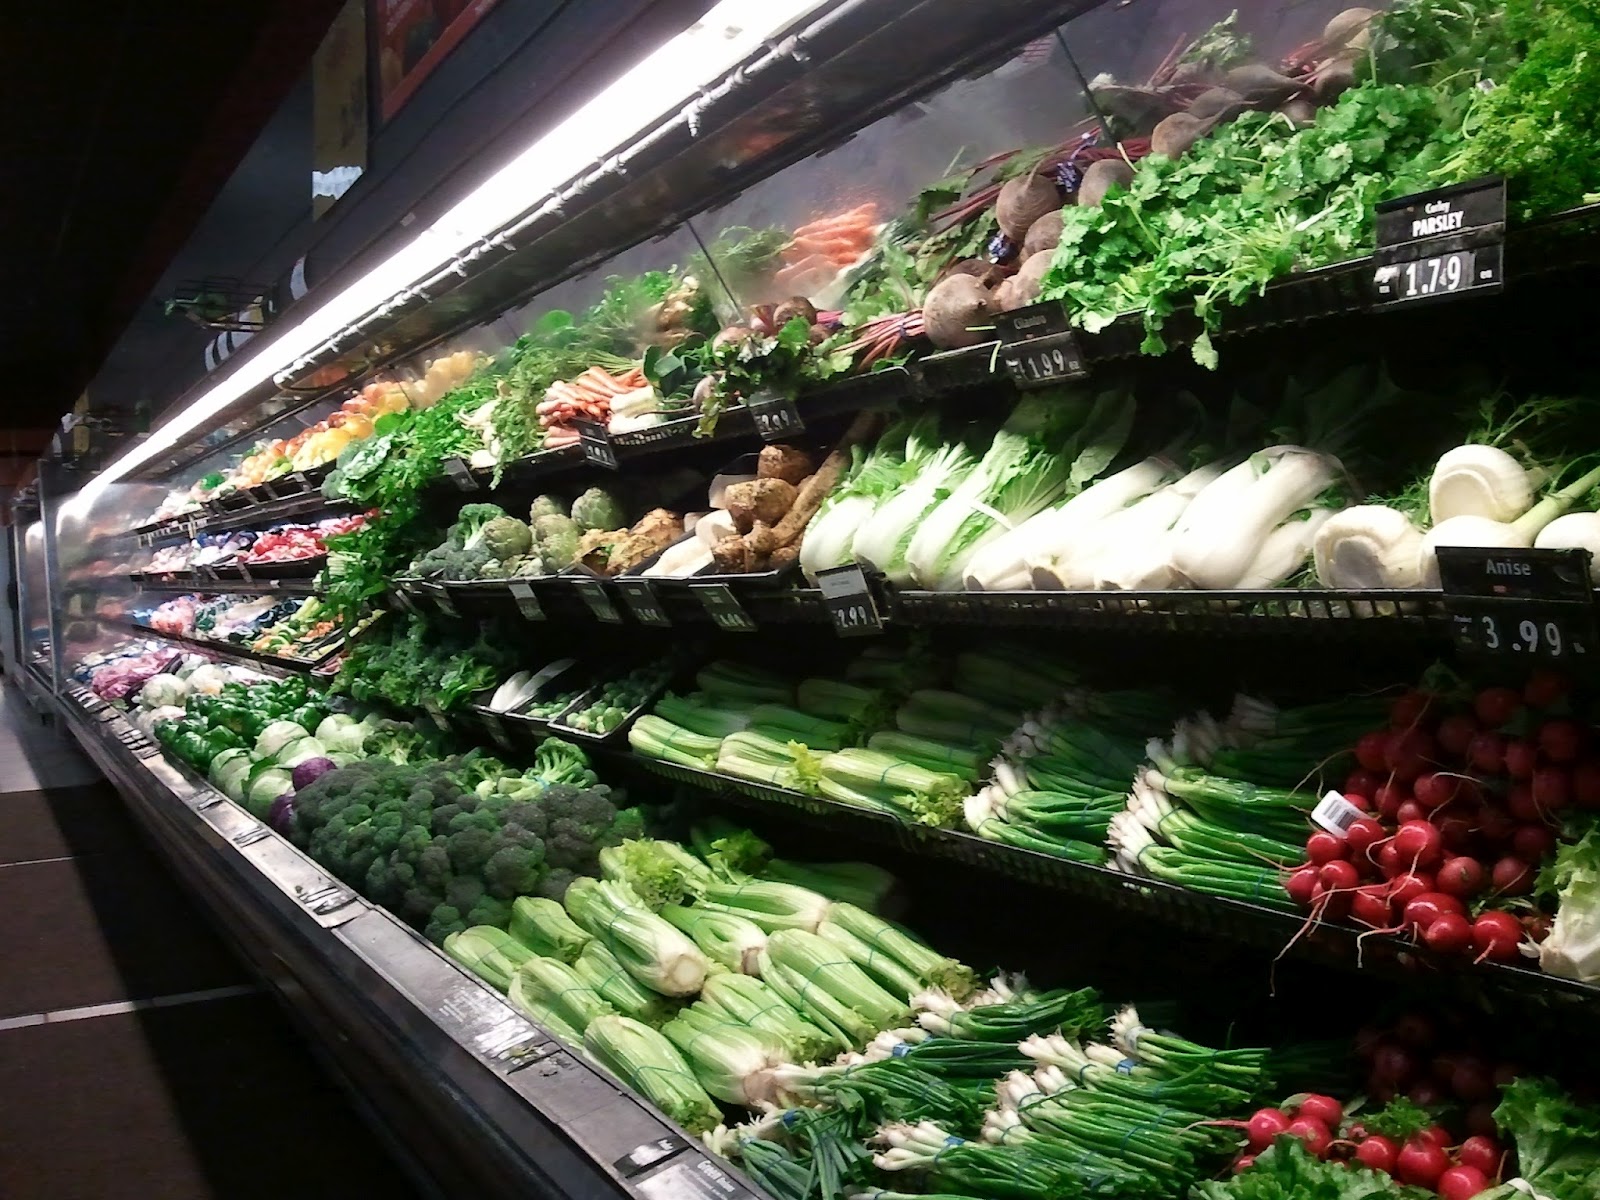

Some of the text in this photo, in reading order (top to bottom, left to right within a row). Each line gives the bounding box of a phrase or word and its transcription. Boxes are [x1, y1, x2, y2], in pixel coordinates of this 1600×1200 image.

[1412, 210, 1465, 238] PARSLEY
[1405, 255, 1461, 297] 1.79
[1486, 558, 1532, 576] Anise
[1481, 615, 1563, 657] 3.99
